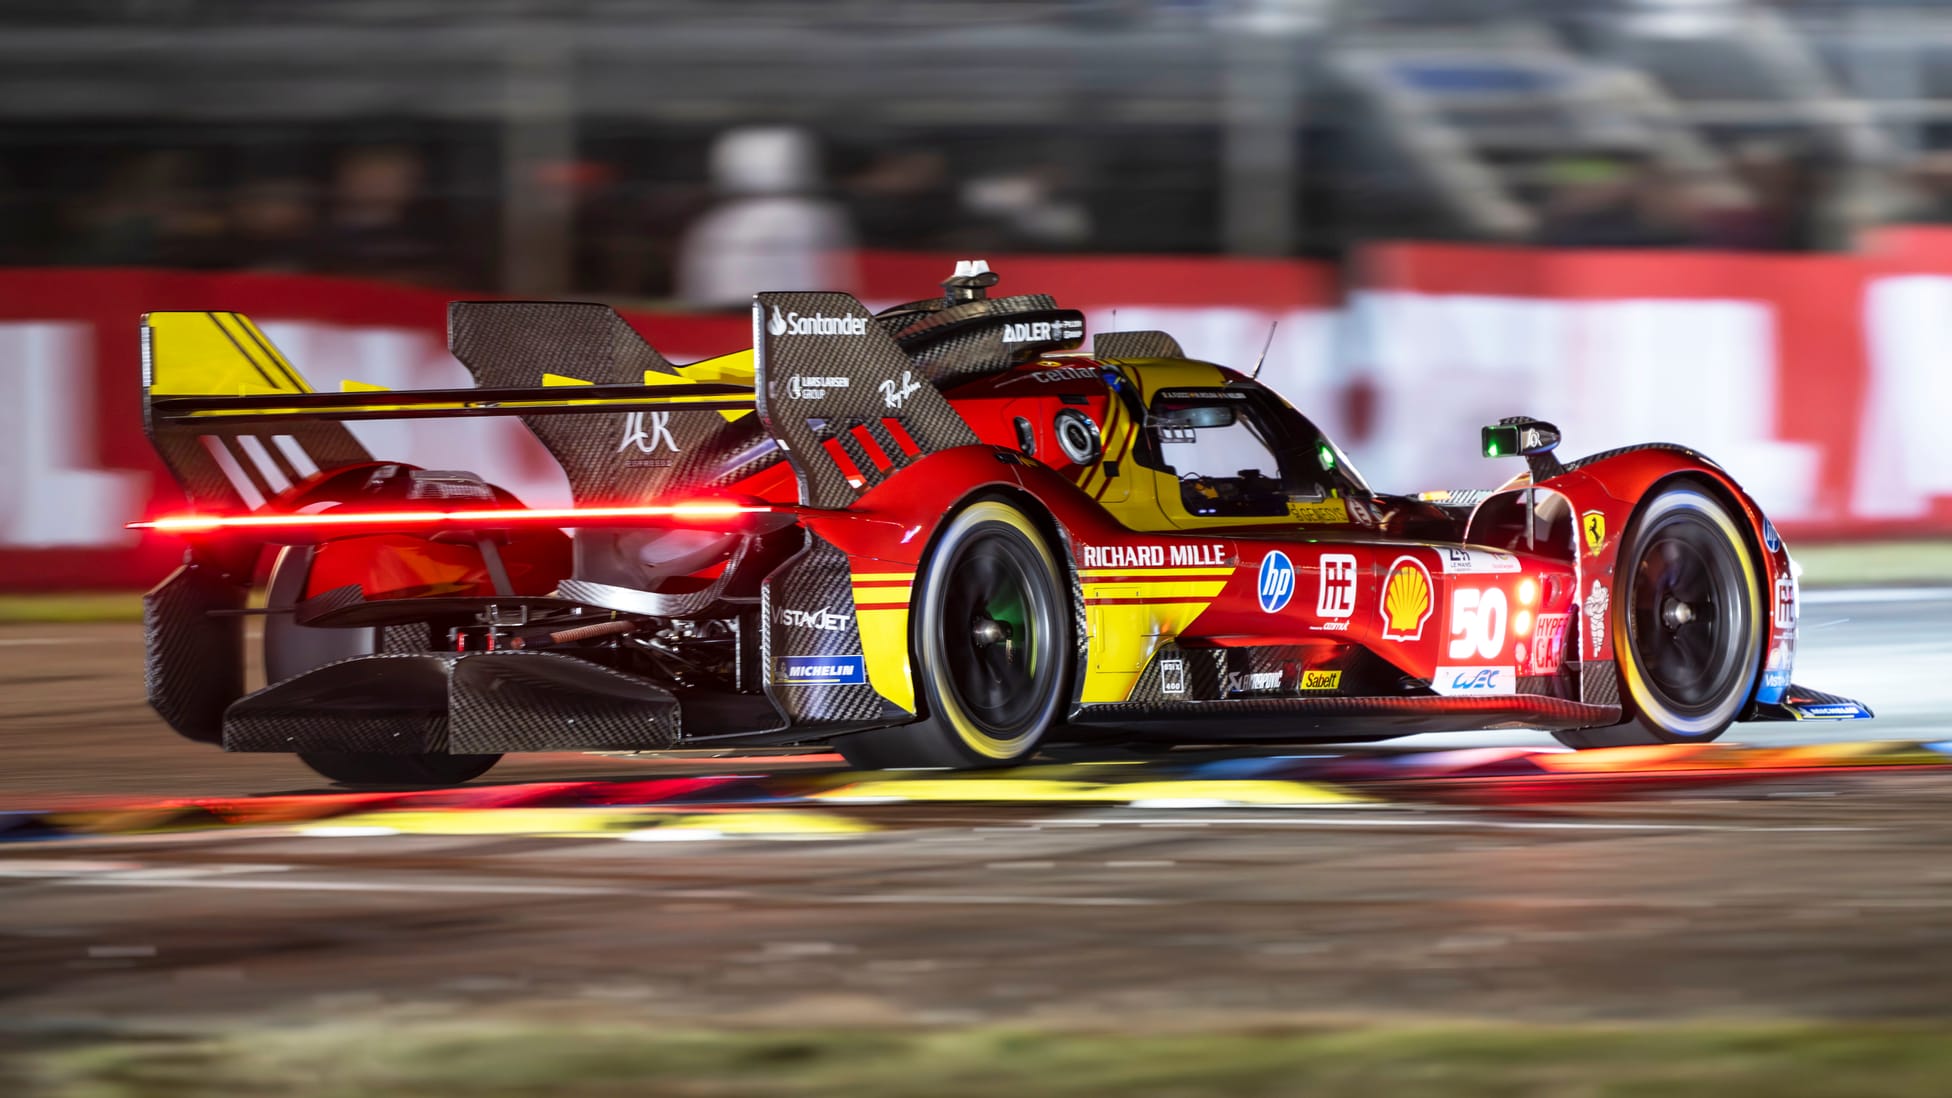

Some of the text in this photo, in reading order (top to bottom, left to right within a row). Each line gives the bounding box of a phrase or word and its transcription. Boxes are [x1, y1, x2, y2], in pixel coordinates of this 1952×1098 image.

[787, 312, 868, 335] Santander
[1002, 322, 1051, 342] ADLER
[802, 389, 826, 399] GROUP
[1083, 544, 1225, 567] RICHARD MILLE
[1262, 552, 1291, 612] hp
[1449, 587, 1508, 659] 50
[789, 665, 854, 677] MICHELIN
[1306, 673, 1336, 688] Sabelt
[1452, 669, 1500, 689] WEC
